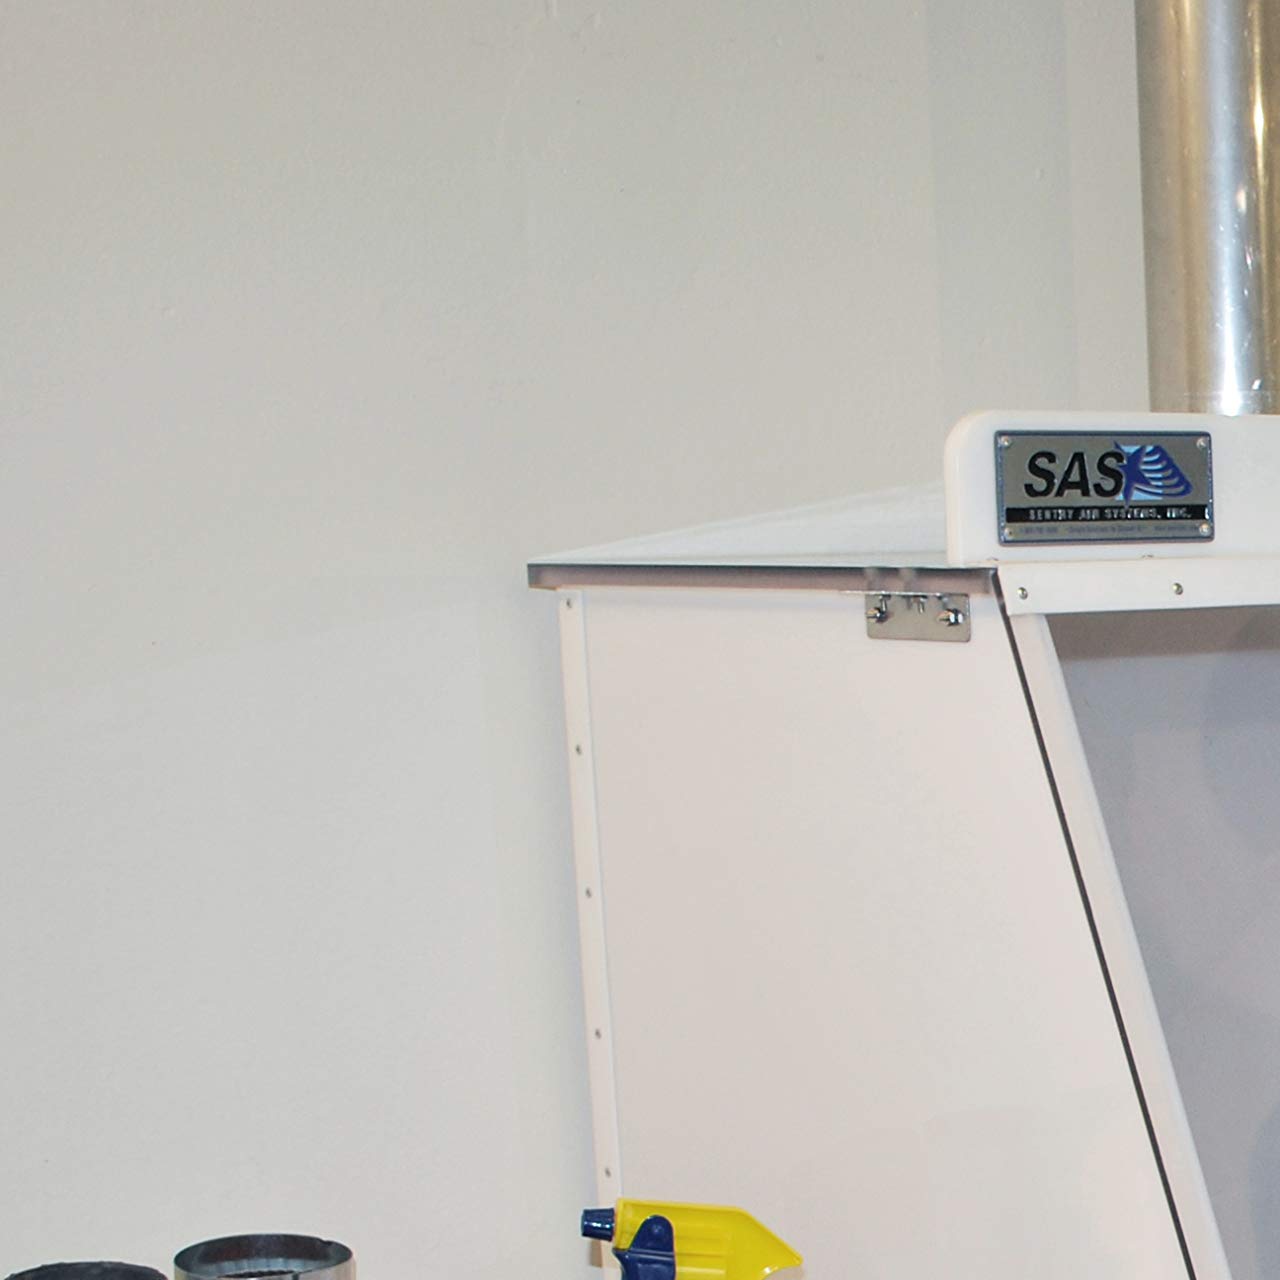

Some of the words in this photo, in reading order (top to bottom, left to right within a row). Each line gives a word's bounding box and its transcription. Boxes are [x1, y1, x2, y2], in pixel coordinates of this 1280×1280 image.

[1024, 450, 1125, 498] SAS
[1029, 508, 1074, 520] SENTRY
[1079, 508, 1100, 520] AIR
